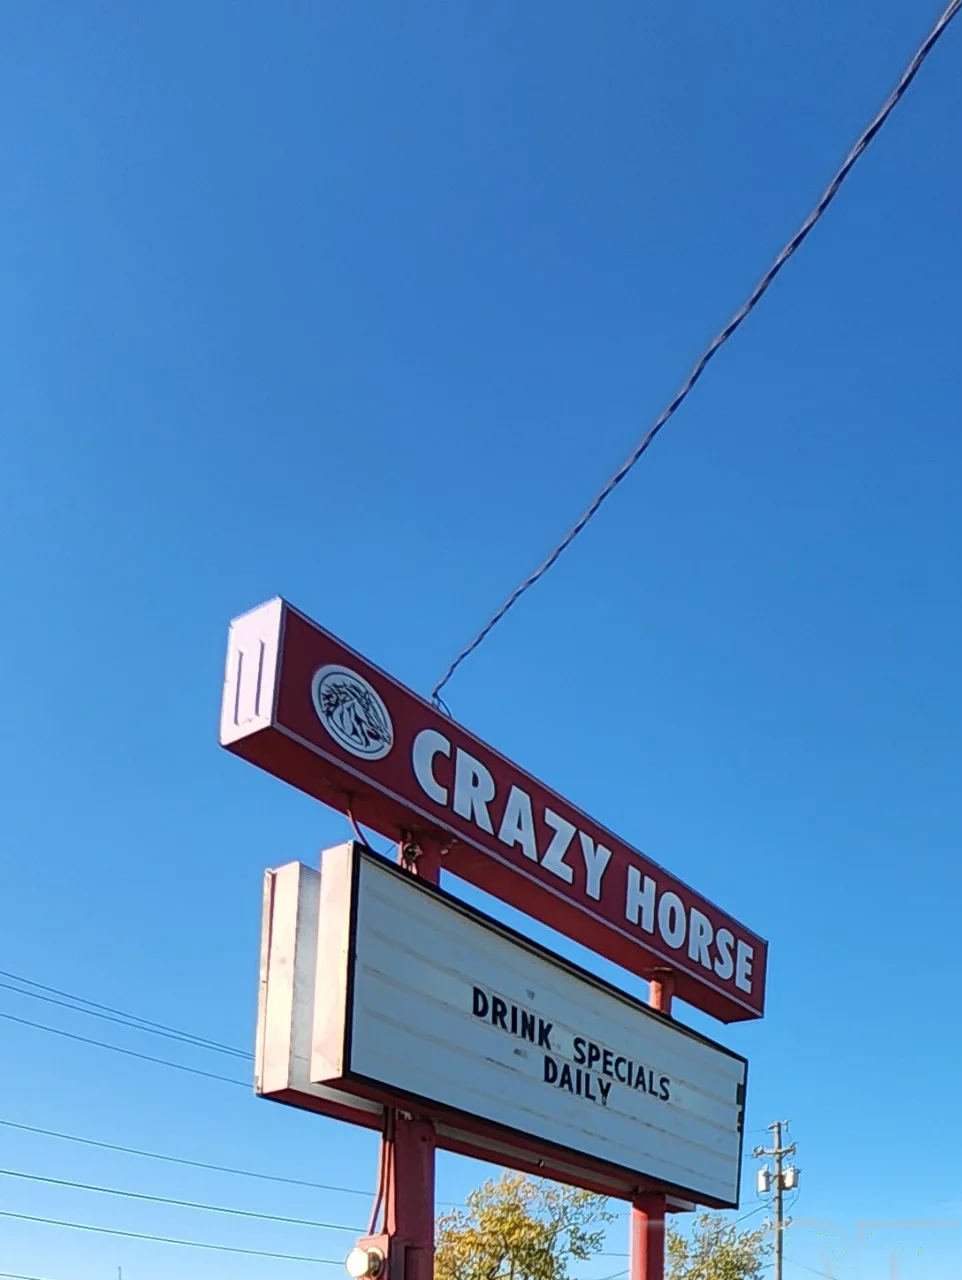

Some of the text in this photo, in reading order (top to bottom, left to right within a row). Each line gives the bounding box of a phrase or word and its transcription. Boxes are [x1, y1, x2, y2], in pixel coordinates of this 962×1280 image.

[412, 728, 754, 996] CRAZY HORSE
[473, 986, 671, 1102] DRINK SPECIALS
[544, 1055, 612, 1106] DAILY
